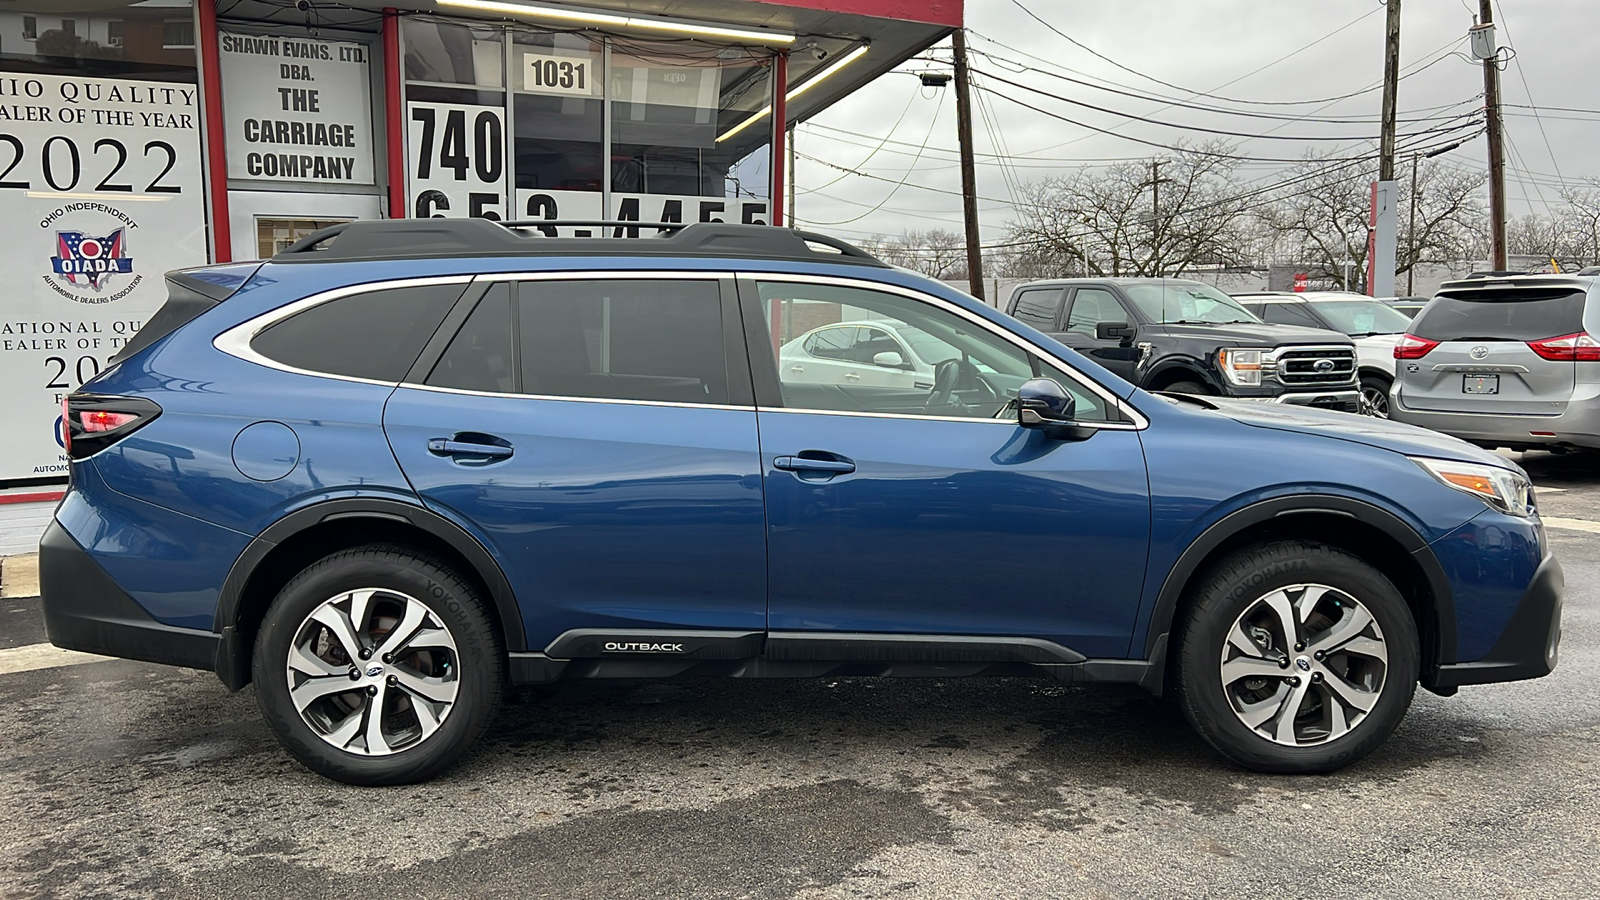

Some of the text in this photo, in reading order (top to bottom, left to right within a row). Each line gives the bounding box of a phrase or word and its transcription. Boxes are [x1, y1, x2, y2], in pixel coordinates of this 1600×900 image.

[222, 36, 367, 63] SHAWN EVANS. LTD.
[280, 63, 315, 81] DBA.
[531, 59, 585, 89] 1031
[0, 78, 194, 106] IO QUALITY
[277, 87, 320, 113] THE
[58, 107, 87, 124] OF
[91, 109, 135, 126] THE
[139, 112, 194, 129] YEAR
[243, 118, 356, 148] CARRIAGE
[412, 107, 503, 183] 740
[0, 133, 182, 193] 2022
[246, 152, 355, 180] COMPANY
[40, 202, 139, 230] OHIO INDEPENDENT
[61, 259, 120, 273] OIADA
[42, 274, 143, 305] AUTOMOBILE DEALERS ASSOCIATION
[1, 321, 103, 335] ATIONAL
[3, 339, 68, 351] EALER
[77, 338, 101, 349] OF
[44, 354, 117, 389] 20
[1226, 560, 1309, 603] YOKOHAMA
[425, 579, 482, 656] YOKOHAMA
[604, 641, 684, 652] OUTBACK
